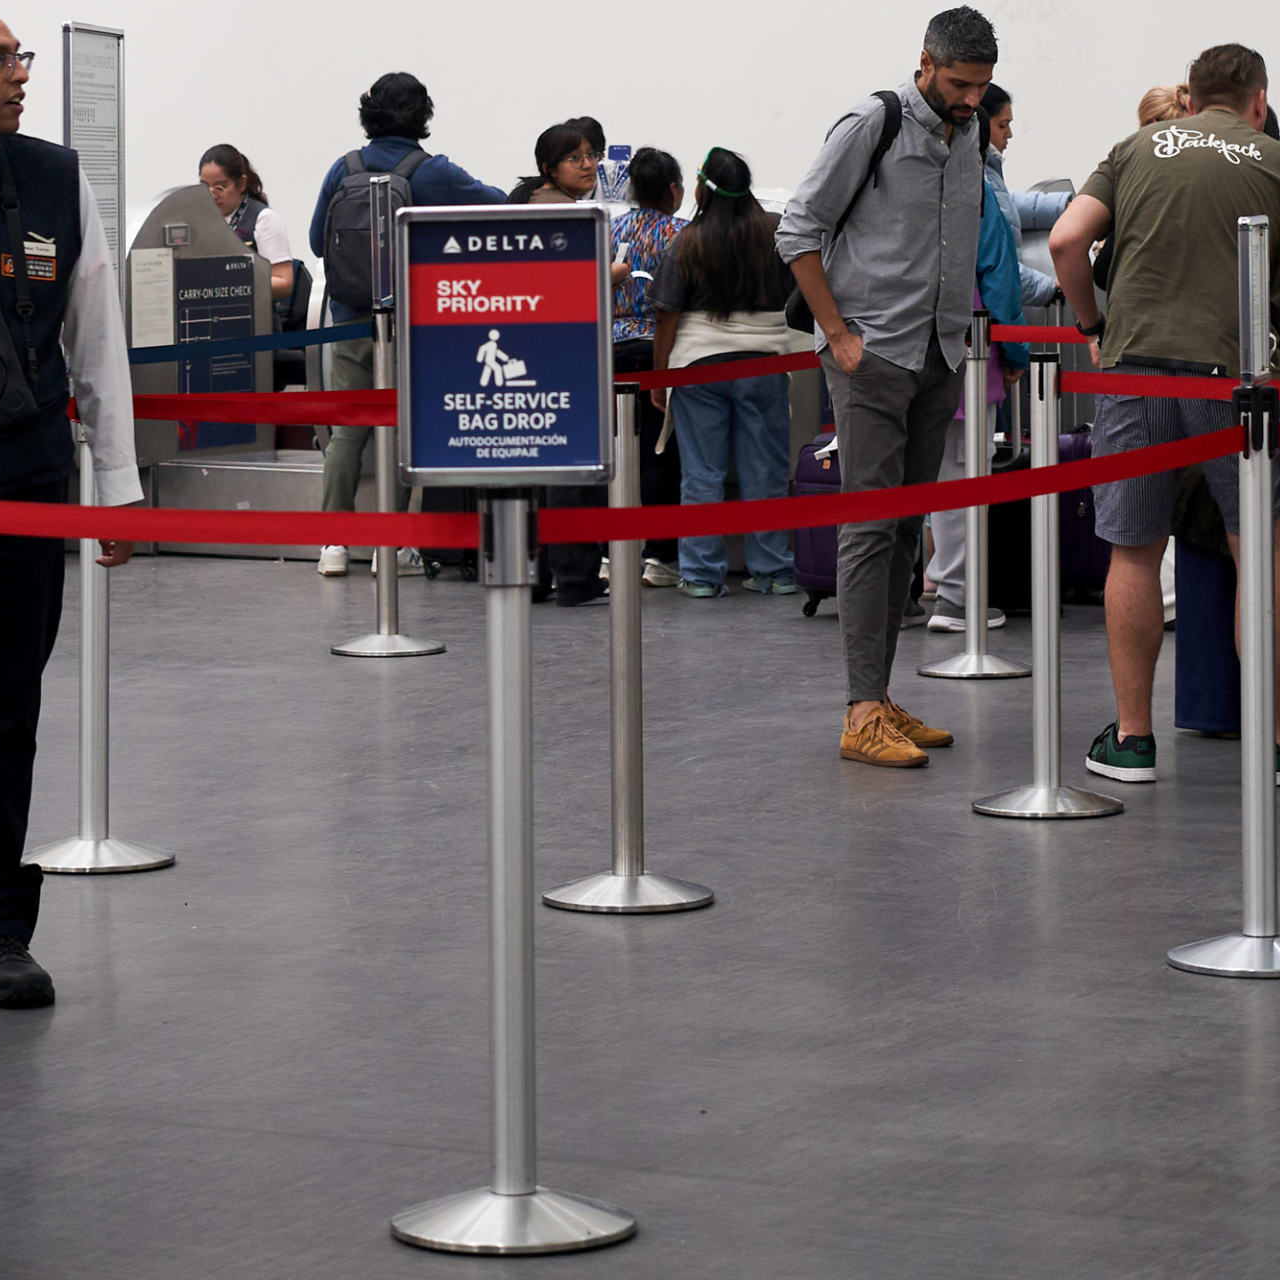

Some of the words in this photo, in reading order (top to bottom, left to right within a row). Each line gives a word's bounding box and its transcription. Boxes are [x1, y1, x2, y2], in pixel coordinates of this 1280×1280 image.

[468, 235, 544, 252] DELTA
[179, 288, 213, 300] CARRY-ON
[215, 286, 228, 297] SIZE
[230, 285, 252, 297] CHECK
[436, 280, 482, 296] SKY
[436, 295, 540, 312] PRIORITY
[443, 392, 570, 411] SELF-SERVICE
[458, 413, 498, 431] BAG
[503, 412, 557, 430] DROP
[448, 434, 567, 447] AUTODOCUMENTACIÓN
[476, 448, 490, 458] DE
[492, 447, 539, 458] EQUIPAJE
